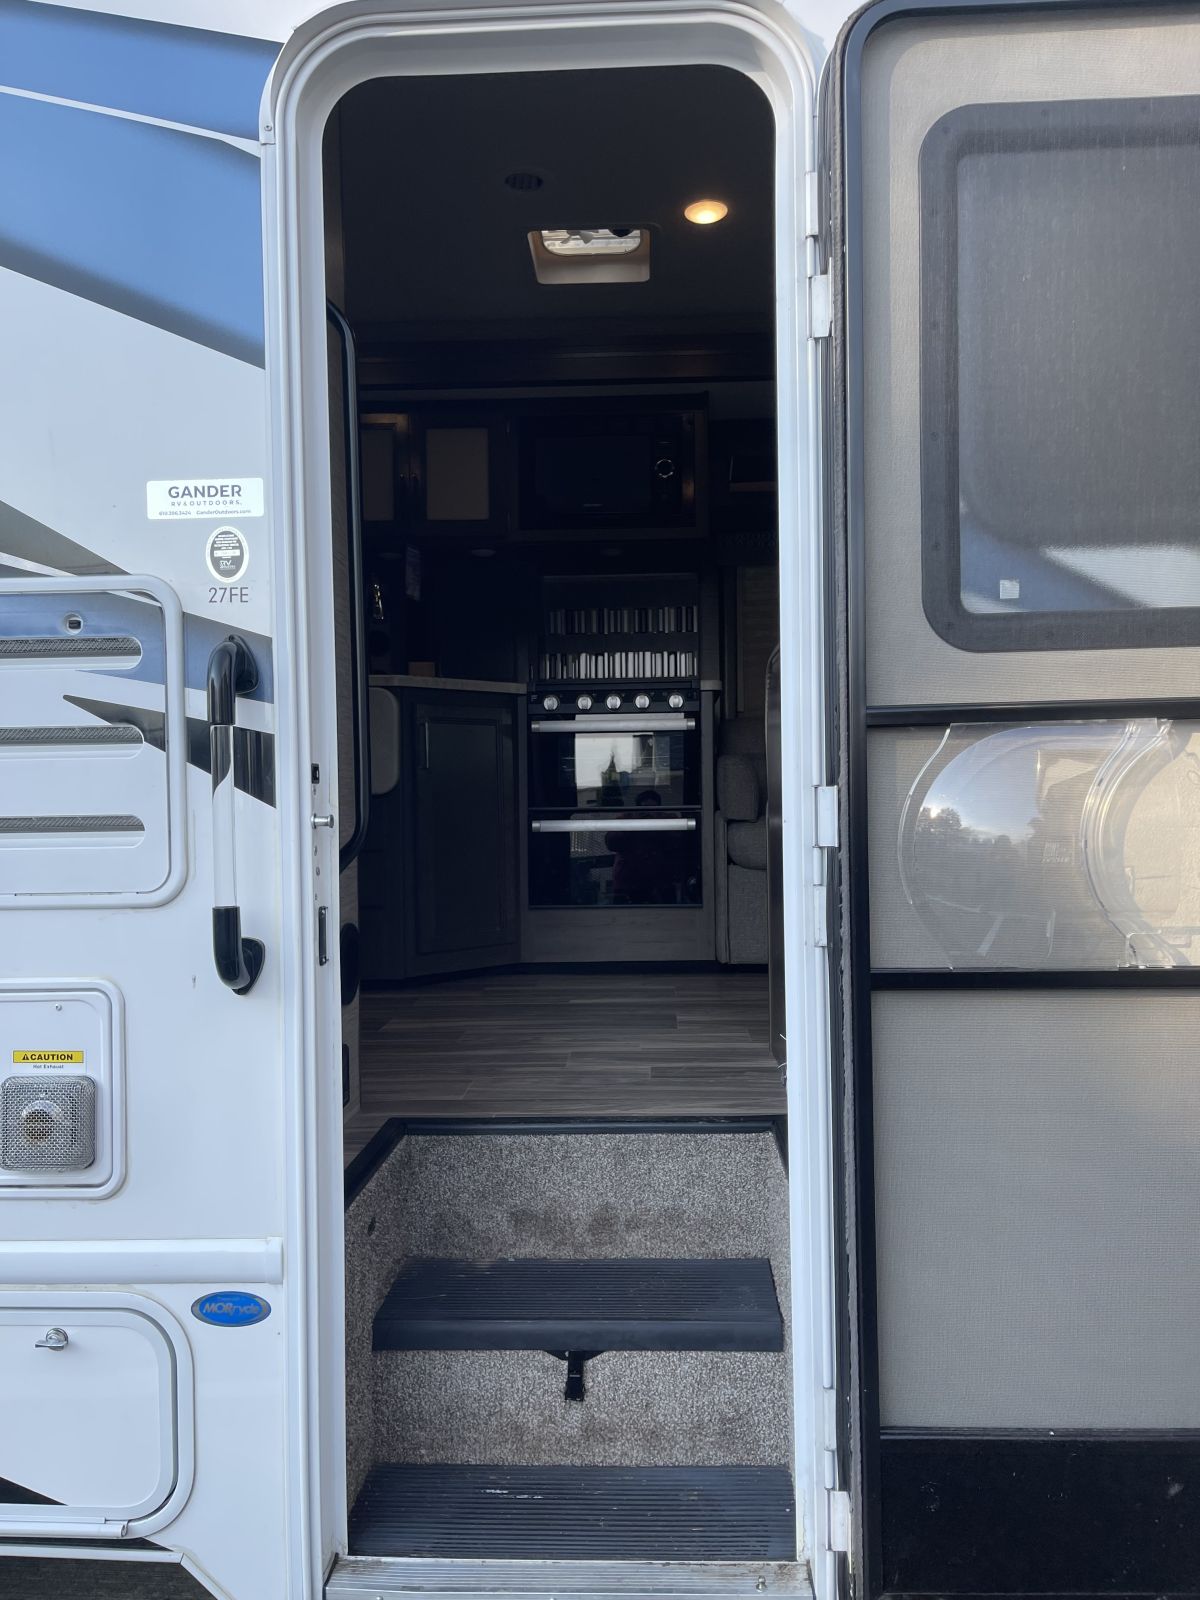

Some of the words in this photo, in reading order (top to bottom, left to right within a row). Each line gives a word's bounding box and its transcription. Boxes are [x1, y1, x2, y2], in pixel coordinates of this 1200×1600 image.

[168, 484, 242, 499] GANDER
[208, 587, 249, 603] 27FE
[30, 1053, 73, 1061] CAUTION
